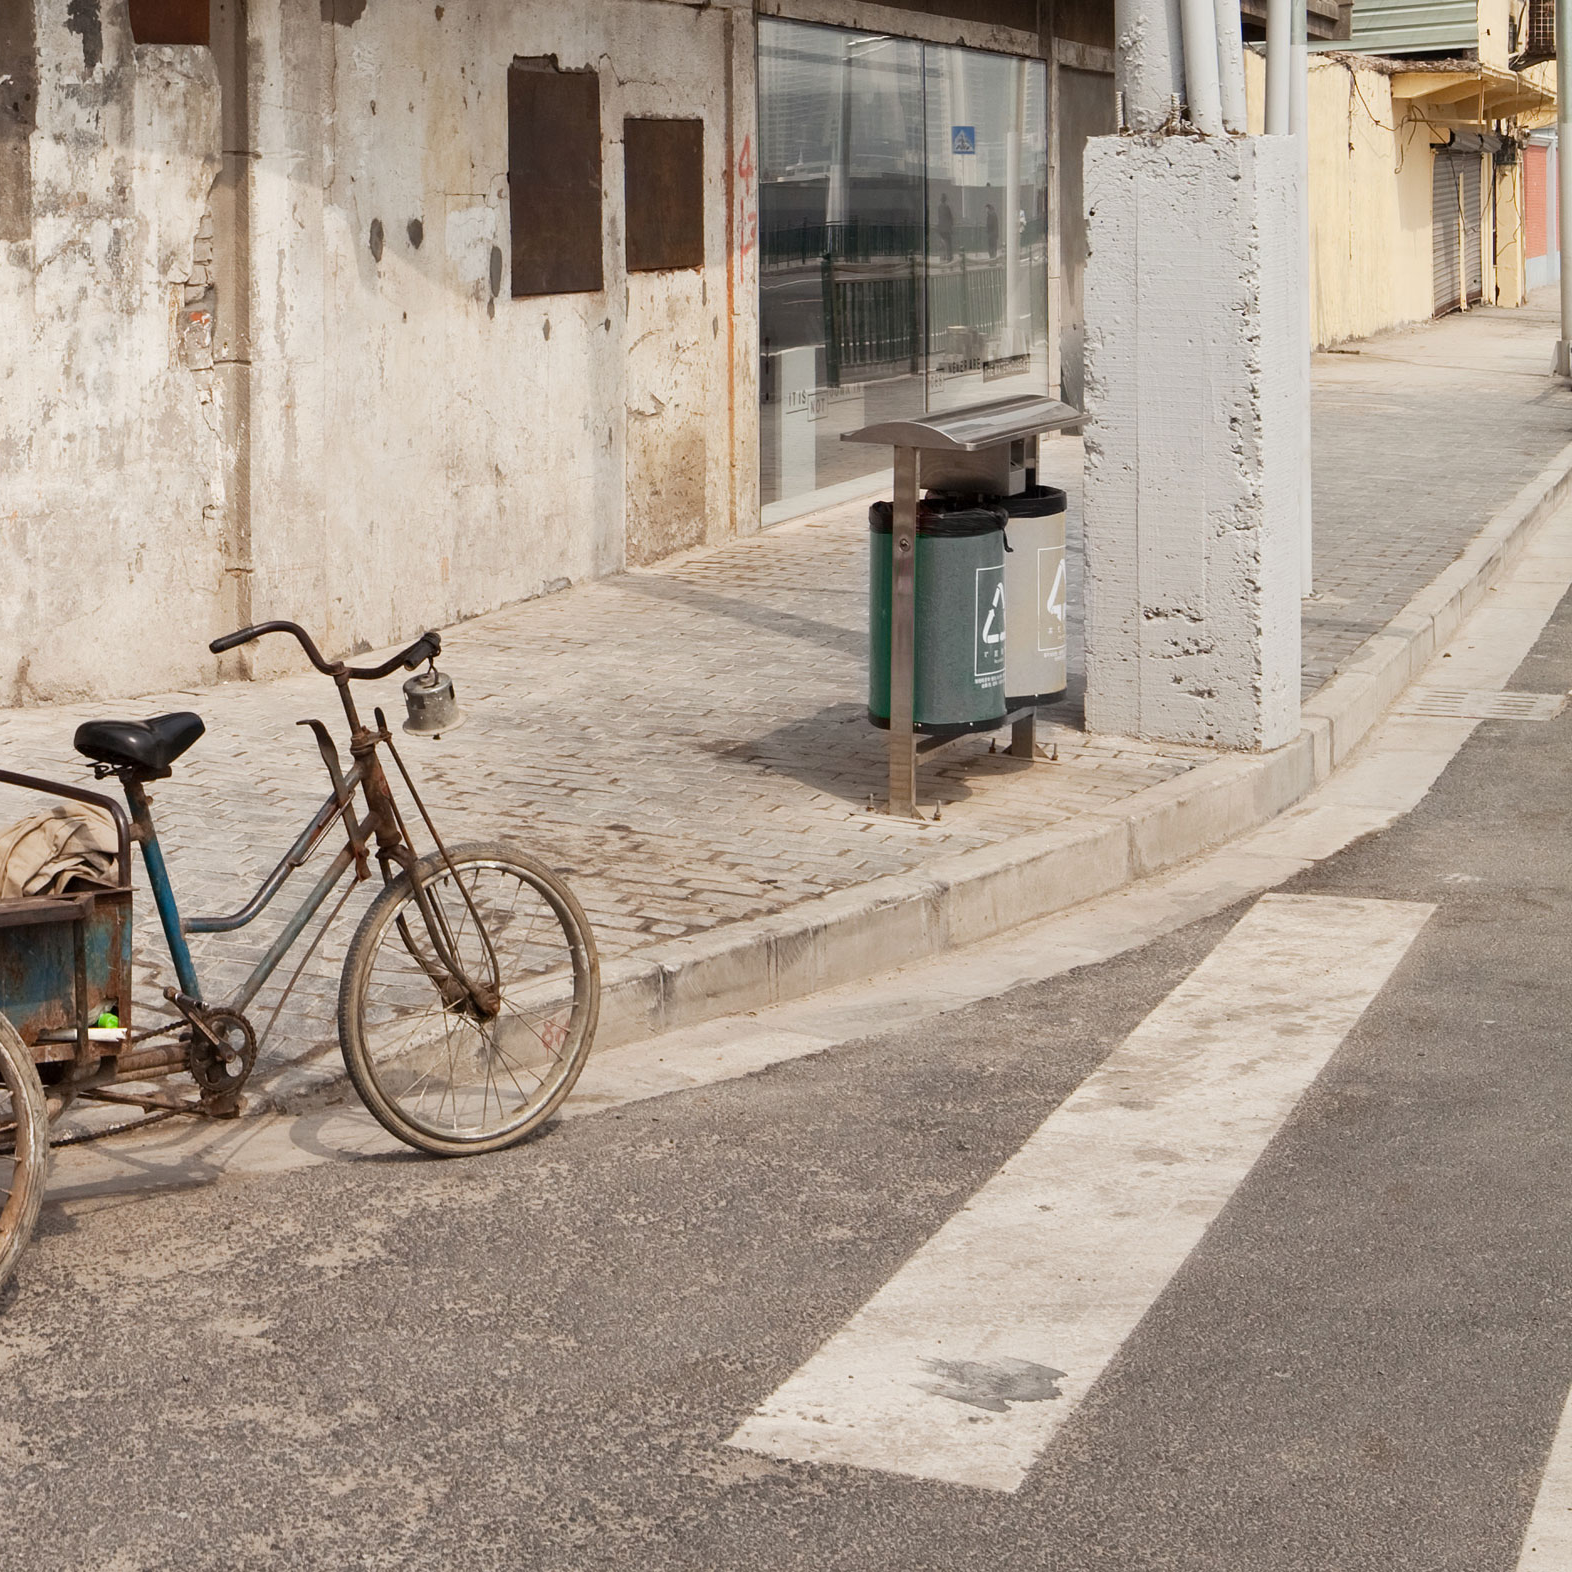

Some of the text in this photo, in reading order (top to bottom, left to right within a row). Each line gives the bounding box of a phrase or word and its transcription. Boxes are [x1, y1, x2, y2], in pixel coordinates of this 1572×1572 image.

[788, 389, 807, 407] IT IS
[810, 398, 825, 414] NOT
